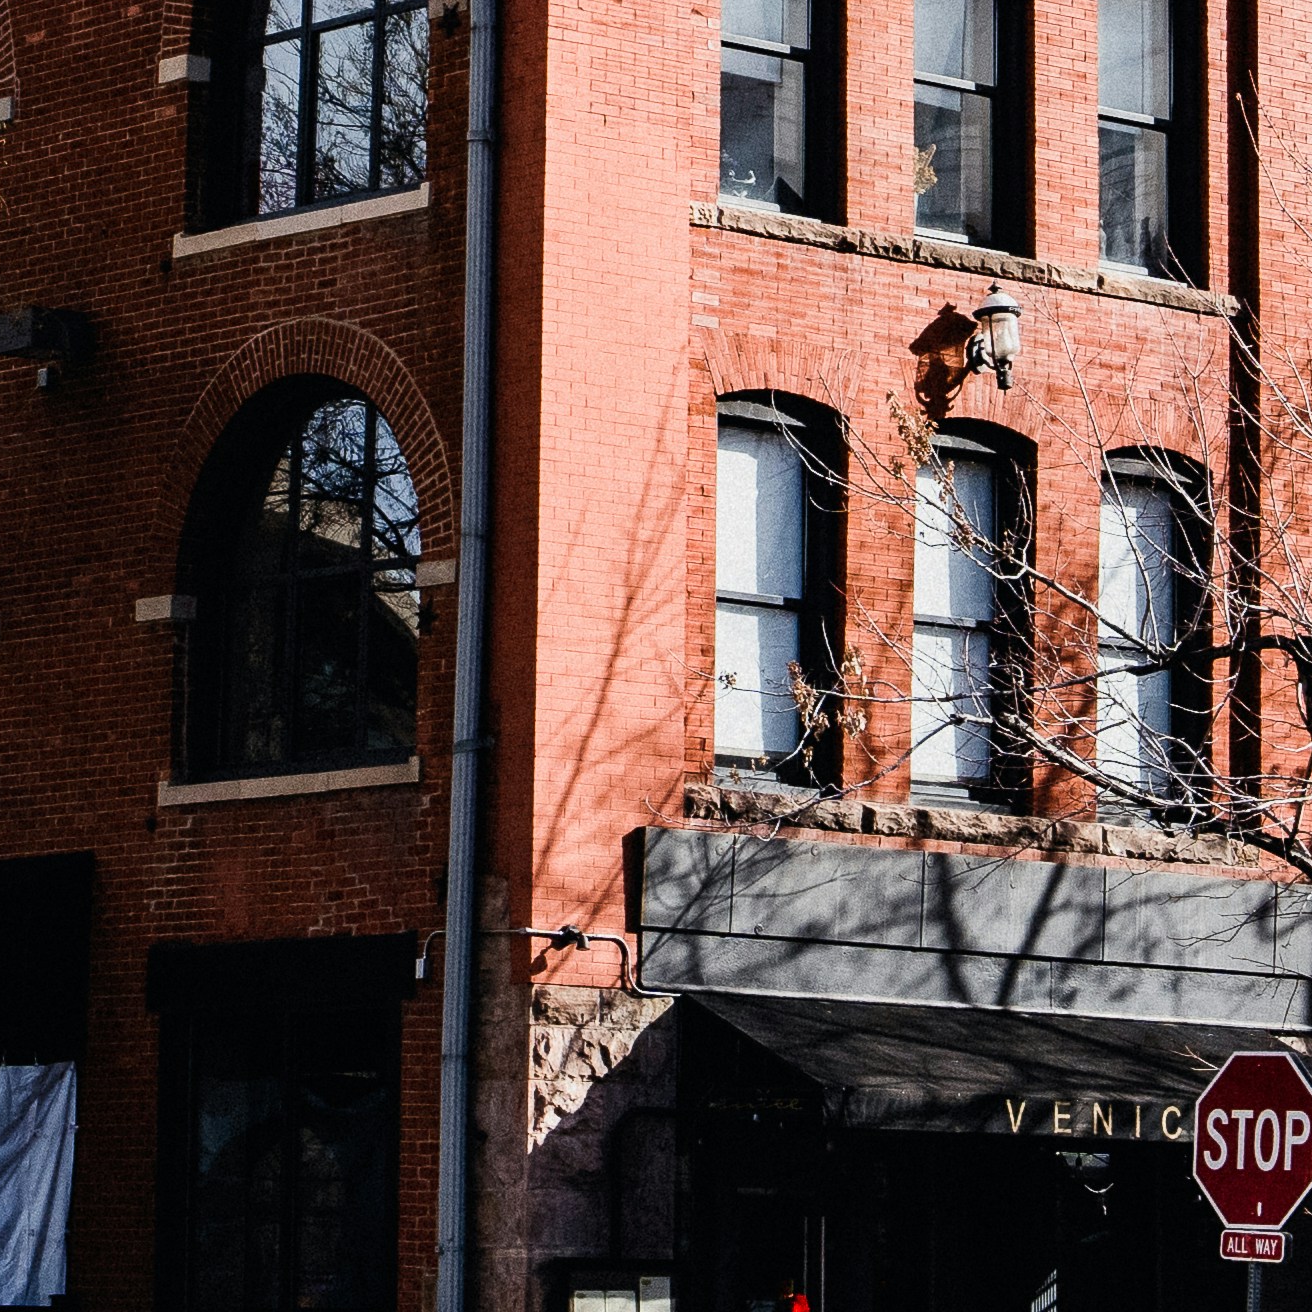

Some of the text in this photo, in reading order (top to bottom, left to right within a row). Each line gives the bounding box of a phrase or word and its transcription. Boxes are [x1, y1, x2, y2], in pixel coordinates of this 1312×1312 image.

[1006, 1099, 1183, 1140] VENIC
[1203, 1108, 1311, 1171] STOP
[1226, 1237, 1278, 1255] ALL WAY
